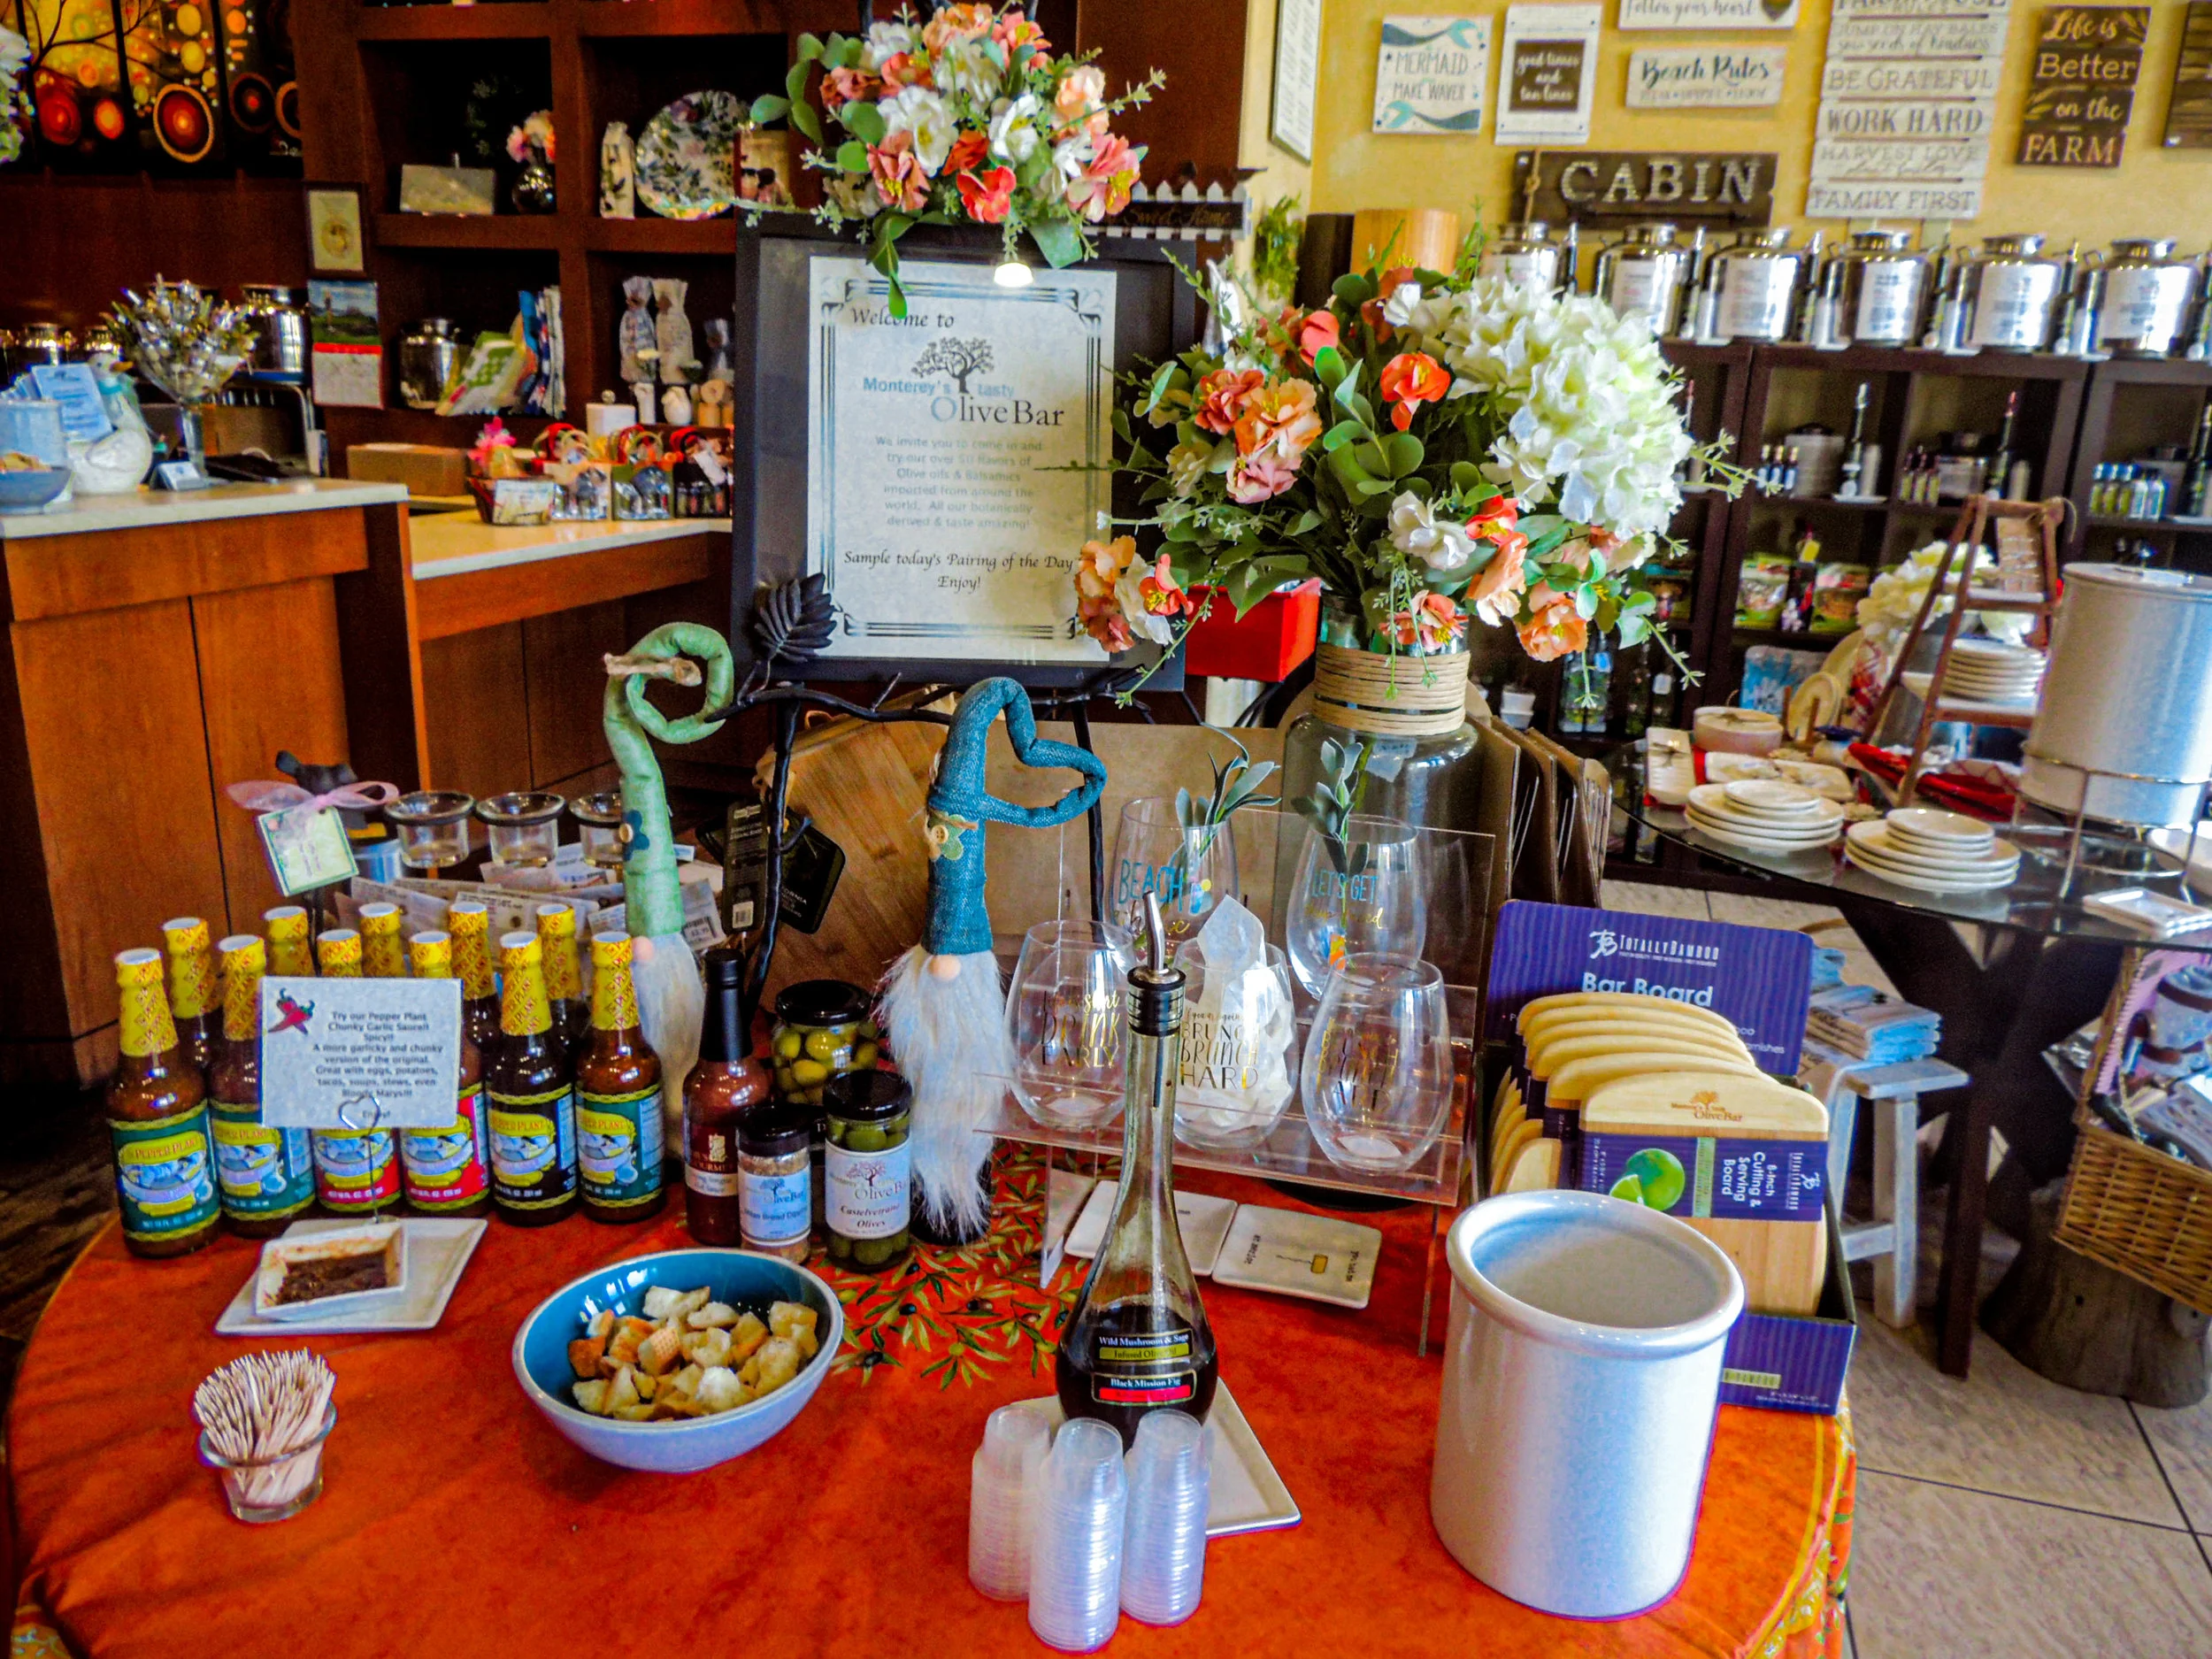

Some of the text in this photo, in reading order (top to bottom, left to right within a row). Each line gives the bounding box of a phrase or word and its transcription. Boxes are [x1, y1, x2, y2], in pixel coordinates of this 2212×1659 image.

[2042, 9, 2118, 41] Life is
[1394, 51, 1469, 75] MERMAID
[1641, 55, 1770, 89] Beach Rules
[2037, 53, 2137, 81] Better
[1828, 66, 1993, 91] BE GRATEFUL
[1393, 82, 1425, 101] MAKE
[2055, 96, 2124, 121] on the
[1827, 107, 1985, 134] WORK HARD
[2023, 134, 2117, 165] FARM
[1561, 160, 1763, 204] CABIN
[1812, 188, 1976, 211] FAMILY FIRST
[937, 313, 955, 329] to
[863, 377, 1015, 398] Monterey's tasty
[876, 436, 893, 446] We
[896, 436, 928, 446] invite
[932, 440, 952, 449] you
[956, 439, 968, 449] to
[1021, 441, 1042, 451] and
[887, 453, 902, 465] try
[930, 455, 955, 465] over
[1019, 456, 1033, 466] of
[896, 467, 926, 479] Olive
[929, 469, 950, 480] oils
[884, 484, 937, 497] imported
[941, 485, 968, 495] from
[1015, 487, 1034, 498] the
[946, 518, 974, 528] taste
[843, 549, 1075, 573] Sample today's Pairing of the Day
[937, 575, 981, 595] Enjoy!
[1118, 858, 1184, 913] BEACH
[1350, 873, 1379, 904] GET
[1582, 972, 1714, 1008] Bar Board
[327, 1023, 365, 1033] Chunky
[366, 1023, 394, 1032] Garlic
[332, 1011, 348, 1022] Try
[368, 1012, 401, 1022] Pepper
[403, 1012, 427, 1021] Plant
[349, 1043, 388, 1054] garlicky
[389, 1043, 407, 1052] and
[410, 1043, 443, 1054] chunky
[315, 1065, 342, 1075] Great
[1180, 1063, 1259, 1090] HARD
[1721, 1157, 1737, 1196] Board
[1733, 1156, 1751, 1202] Serving
[1747, 1151, 1766, 1208] Cutting &
[1764, 1164, 1778, 1197] 8-Inch
[856, 1219, 886, 1229] Olives
[1098, 1333, 1189, 1348] Wild Mushroom & Sage
[1114, 1349, 1142, 1359] Infused
[1110, 1377, 1182, 1388] Black Mission Fig
